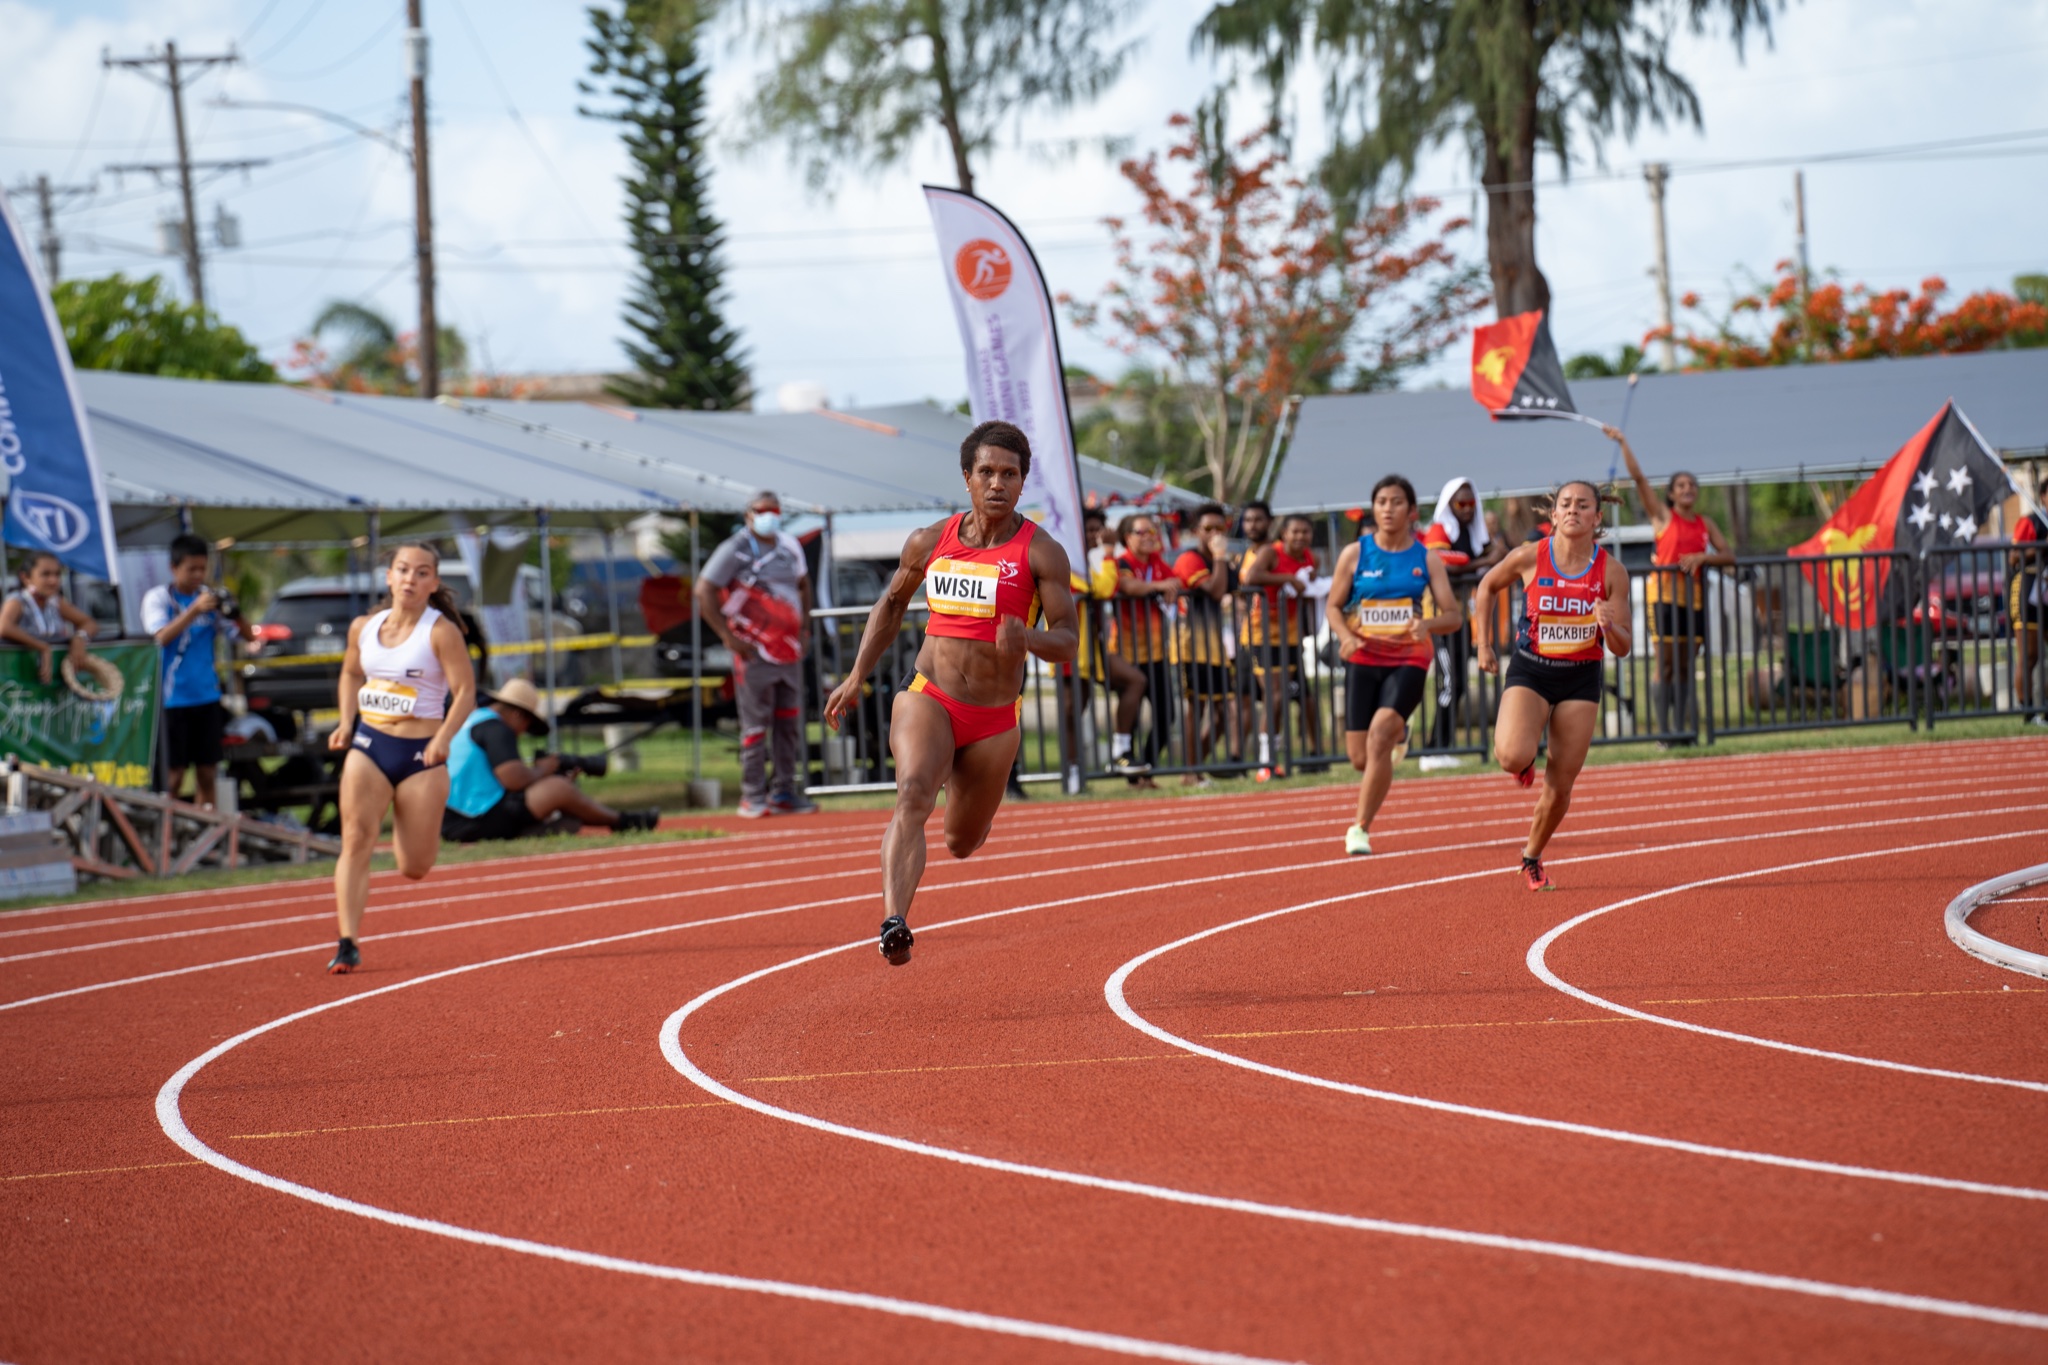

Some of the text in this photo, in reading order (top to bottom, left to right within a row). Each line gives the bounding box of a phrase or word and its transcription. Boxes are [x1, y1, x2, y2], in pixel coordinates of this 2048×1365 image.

[987, 313, 1009, 377] GAMES
[934, 575, 987, 600] WISIL
[941, 603, 960, 611] PACIFIC
[1538, 595, 1596, 615] GUAM
[1363, 609, 1410, 622] TOOMA
[1541, 625, 1596, 640] PACKBIER
